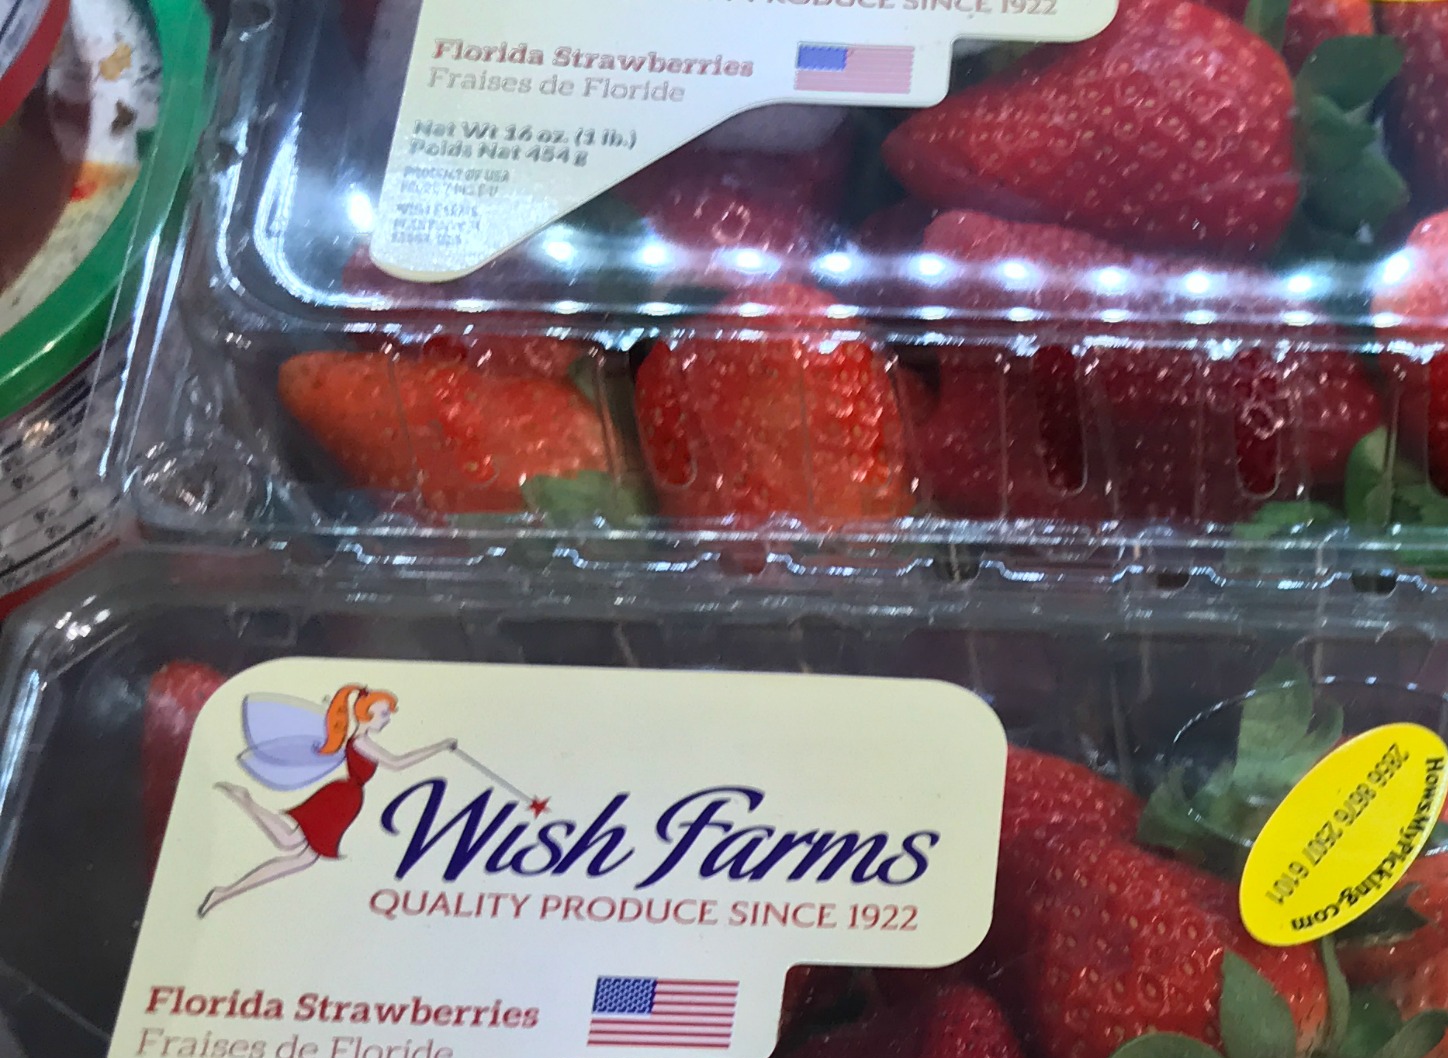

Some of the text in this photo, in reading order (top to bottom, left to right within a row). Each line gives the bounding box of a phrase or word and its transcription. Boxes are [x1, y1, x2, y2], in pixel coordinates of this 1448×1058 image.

[432, 38, 753, 77] Florida Strawberries
[428, 67, 686, 102] Fraises de Floride
[414, 119, 455, 138] Net
[461, 121, 498, 140] Wt
[504, 123, 532, 142] 16
[478, 141, 524, 161] Net
[524, 146, 570, 164] 454
[380, 778, 940, 890] Wish Farms
[369, 888, 919, 932] QUALITY PRODUCE SINCE 1922
[144, 986, 539, 1031] Florida Strawberries
